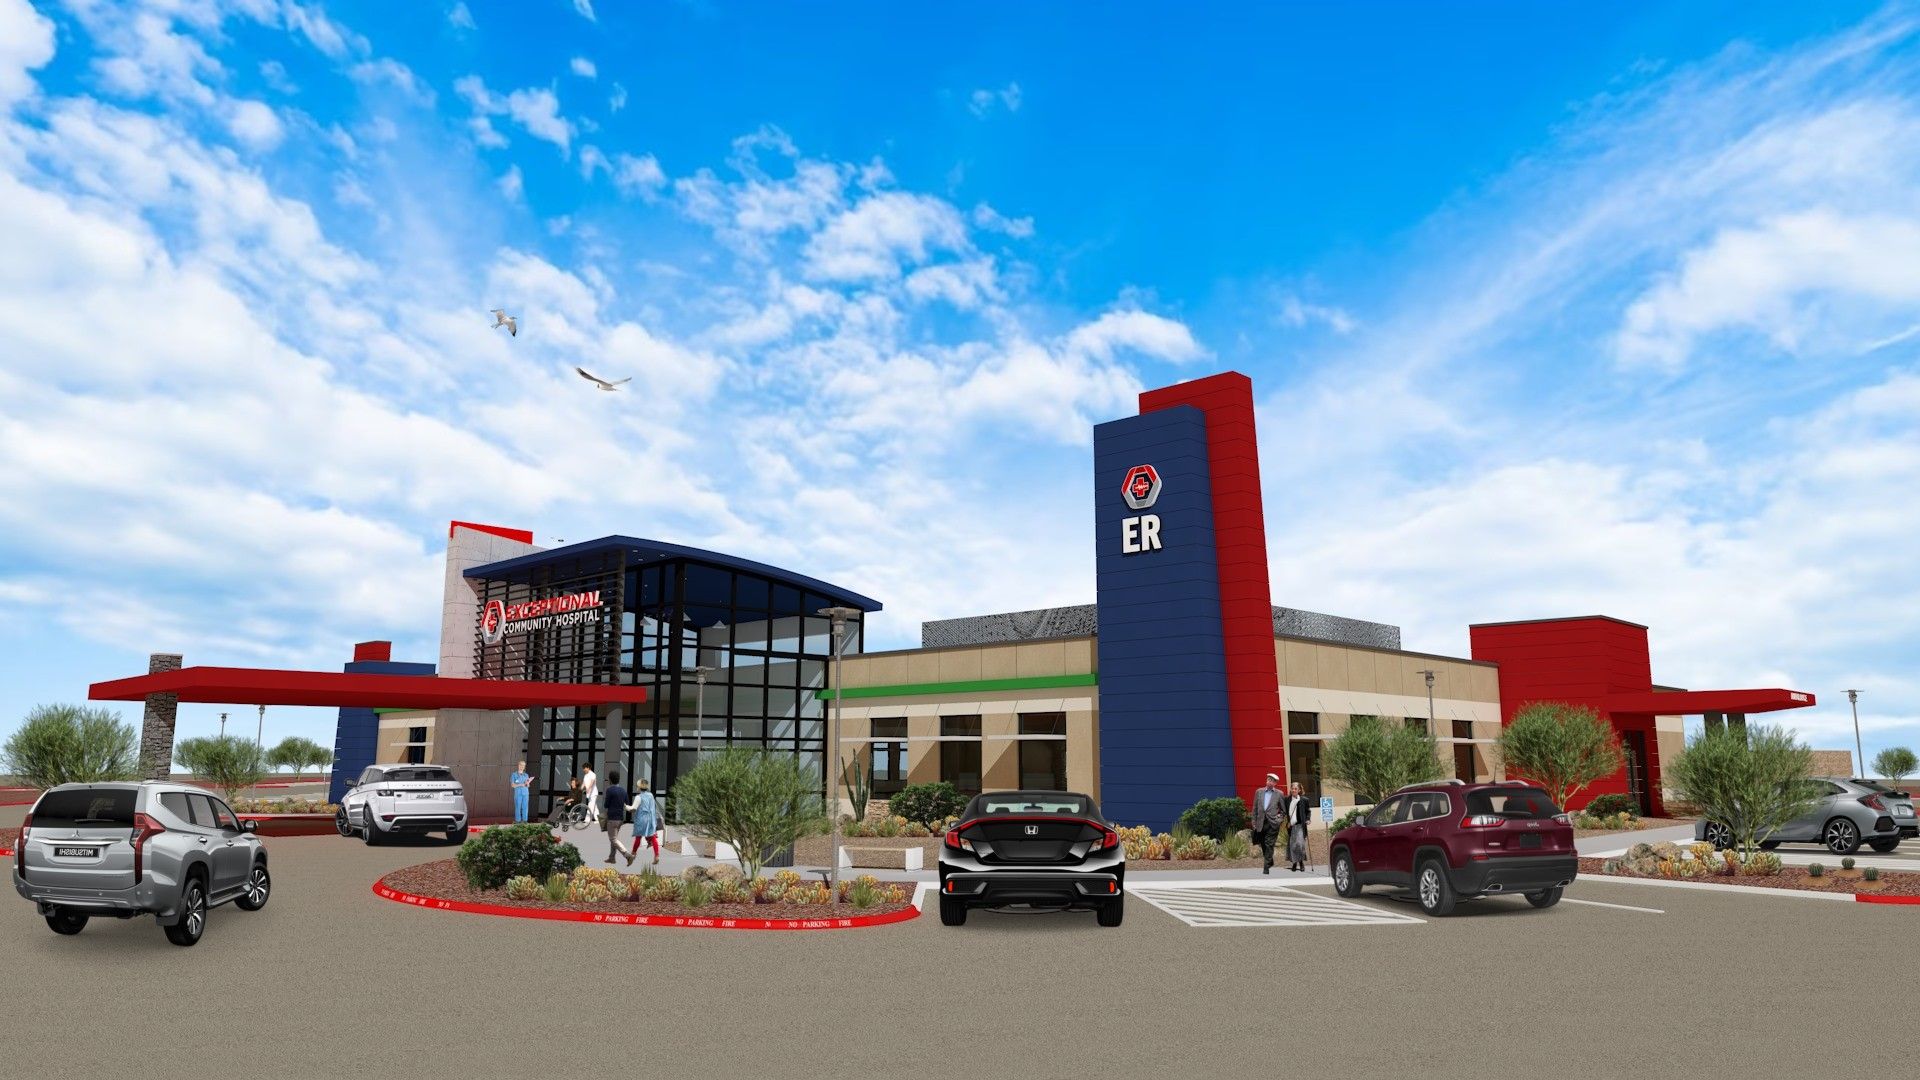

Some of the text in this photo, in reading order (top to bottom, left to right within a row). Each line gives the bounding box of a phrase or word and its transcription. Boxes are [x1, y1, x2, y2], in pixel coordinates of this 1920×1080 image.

[1122, 514, 1162, 554] ER
[506, 590, 604, 621] EXCEPTIONAL
[503, 609, 600, 634] COMMUNITY HOSPITAL
